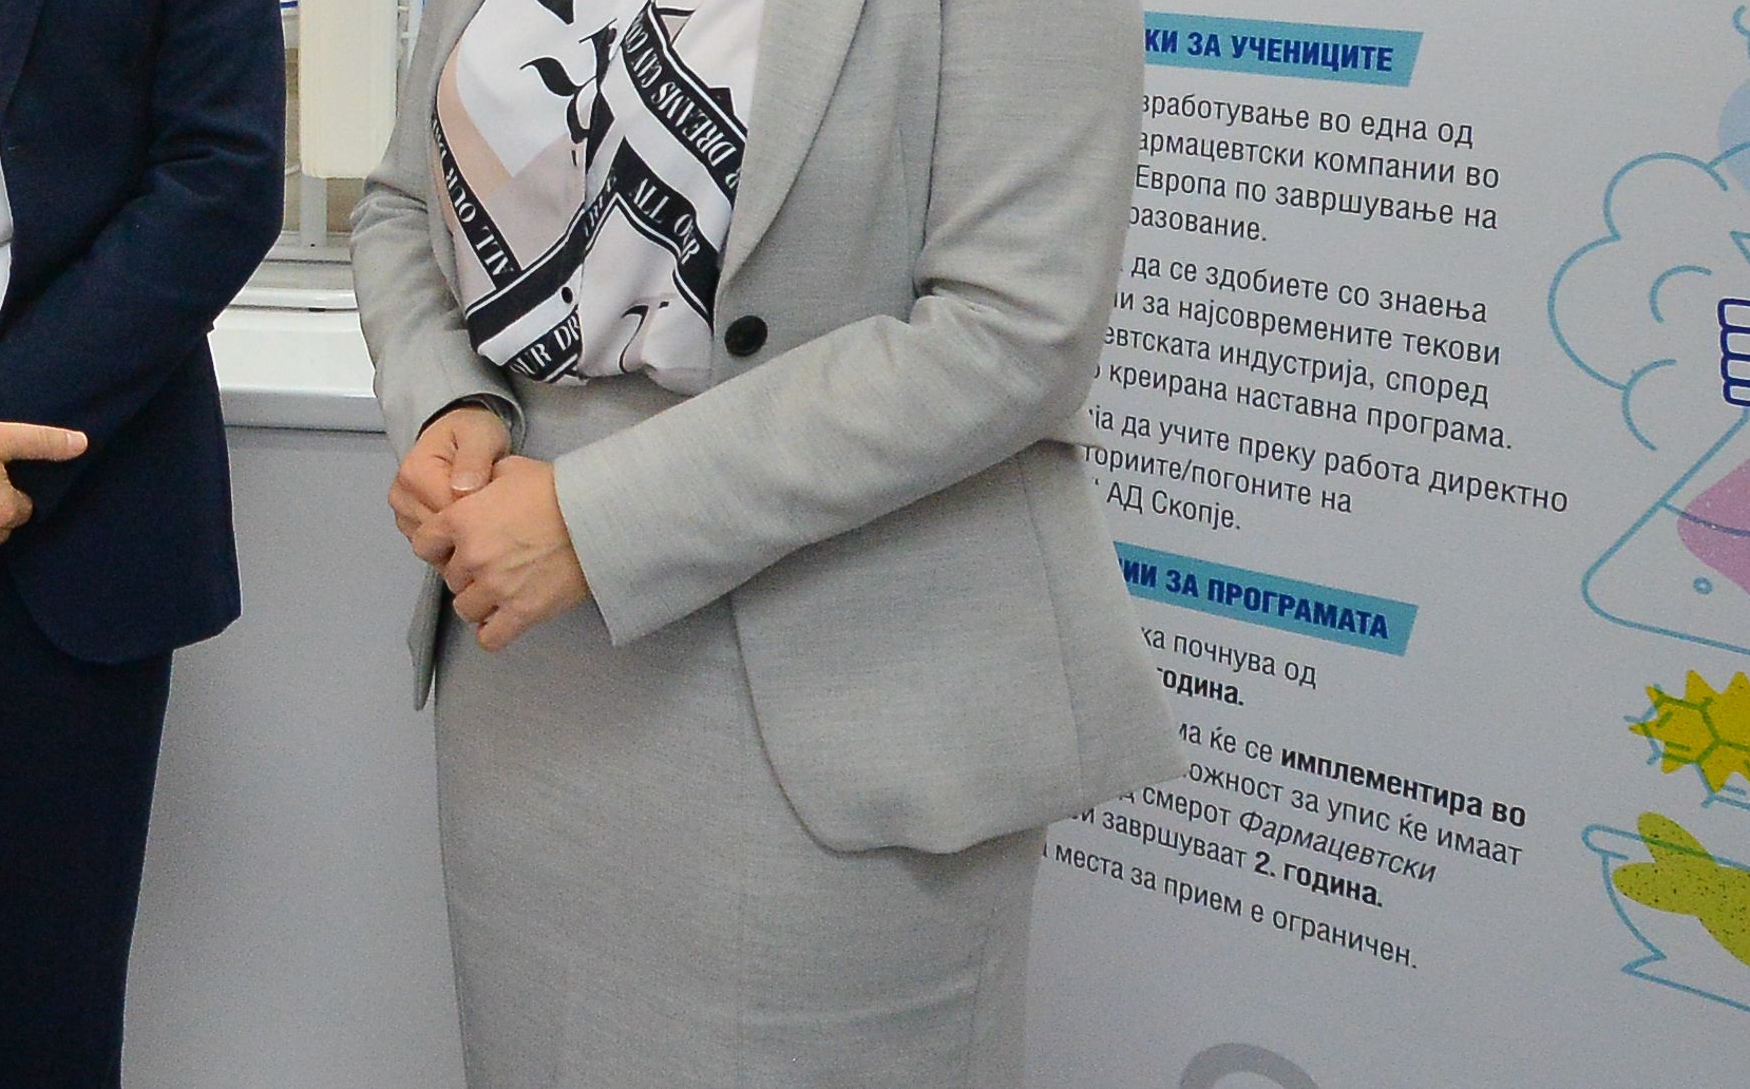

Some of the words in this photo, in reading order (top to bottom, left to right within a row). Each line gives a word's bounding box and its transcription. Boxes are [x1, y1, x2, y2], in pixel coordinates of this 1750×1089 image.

[1187, 31, 1222, 58] ЗА
[1230, 35, 1394, 73] УЧЕНИЦИТЕ
[652, 81, 737, 167] DREAMS
[1319, 112, 1351, 133] во
[1361, 115, 1428, 143] една
[1437, 122, 1473, 150] од
[1135, 164, 1226, 198] Европа
[1235, 181, 1267, 203] по
[1275, 185, 1454, 225] завршување
[1464, 207, 1498, 230] на
[1314, 151, 1455, 184] компании
[1466, 166, 1499, 189] во
[1130, 256, 1161, 280] да
[1169, 261, 1197, 283] се
[1205, 266, 1329, 304] здобиете
[1338, 285, 1370, 307] со
[1378, 290, 1487, 323] знаења
[1142, 294, 1170, 317] за
[1178, 300, 1393, 352] најсовремените
[1402, 332, 1500, 366] текови
[1109, 364, 1228, 402] креирана
[1236, 385, 1357, 424] наставна
[1367, 407, 1512, 450] програма.
[1219, 344, 1375, 391] индустрија,
[1386, 370, 1489, 410] според
[1121, 415, 1151, 439] да
[1158, 421, 1230, 452] учите
[1239, 436, 1316, 472] преку
[1324, 451, 1420, 487] работа
[1427, 470, 1568, 513] директно
[1106, 481, 1143, 515] АД
[1151, 489, 1241, 531] Скопје.
[1321, 490, 1352, 514] на
[1165, 569, 1199, 598] ЗА
[1207, 578, 1388, 640] ПРОГРАМАТА
[1156, 667, 1245, 707] одина.
[1173, 635, 1276, 677] почнува
[1284, 661, 1317, 691] од
[1209, 726, 1237, 754] ќе
[1245, 740, 1273, 763] се
[1280, 747, 1483, 817] имплементира
[1491, 801, 1526, 827] во
[1142, 786, 1232, 826] смерот
[1240, 810, 1437, 884] Фармацевтски
[1182, 763, 1284, 803] ожност
[1290, 789, 1319, 814] за
[1326, 798, 1390, 832] упис
[1399, 812, 1428, 842] ќе
[1437, 827, 1523, 866] имаат
[1102, 811, 1247, 868] завршуваат
[1253, 850, 1276, 878] 2.
[1283, 862, 1383, 908] година.
[1055, 844, 1124, 881] места
[1130, 866, 1157, 891] за
[1164, 877, 1242, 917] прием
[1250, 903, 1264, 923] е
[1272, 910, 1417, 969] ограничен.
